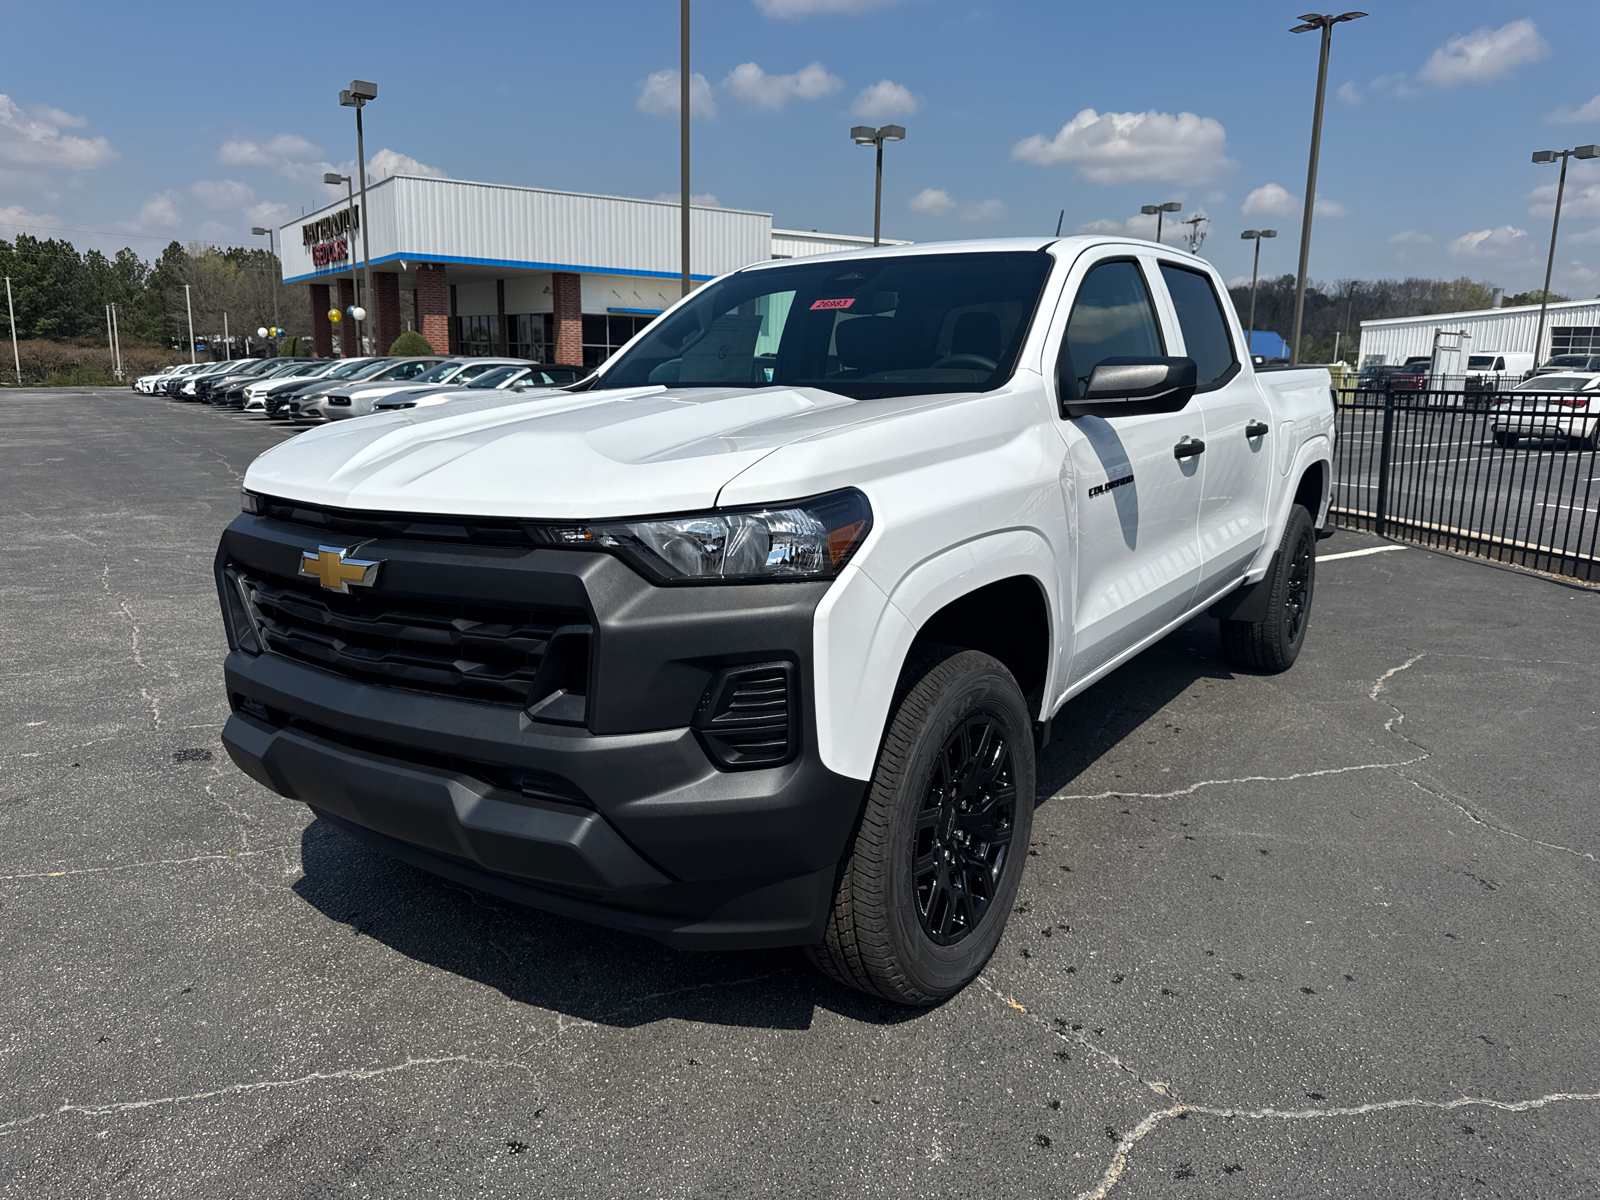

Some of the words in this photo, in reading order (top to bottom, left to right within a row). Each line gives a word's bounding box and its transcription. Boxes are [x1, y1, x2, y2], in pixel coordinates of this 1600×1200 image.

[312, 242, 329, 266] USED
[328, 237, 348, 263] CARS
[815, 299, 848, 308] 26983
[1088, 474, 1134, 497] COLORADO
